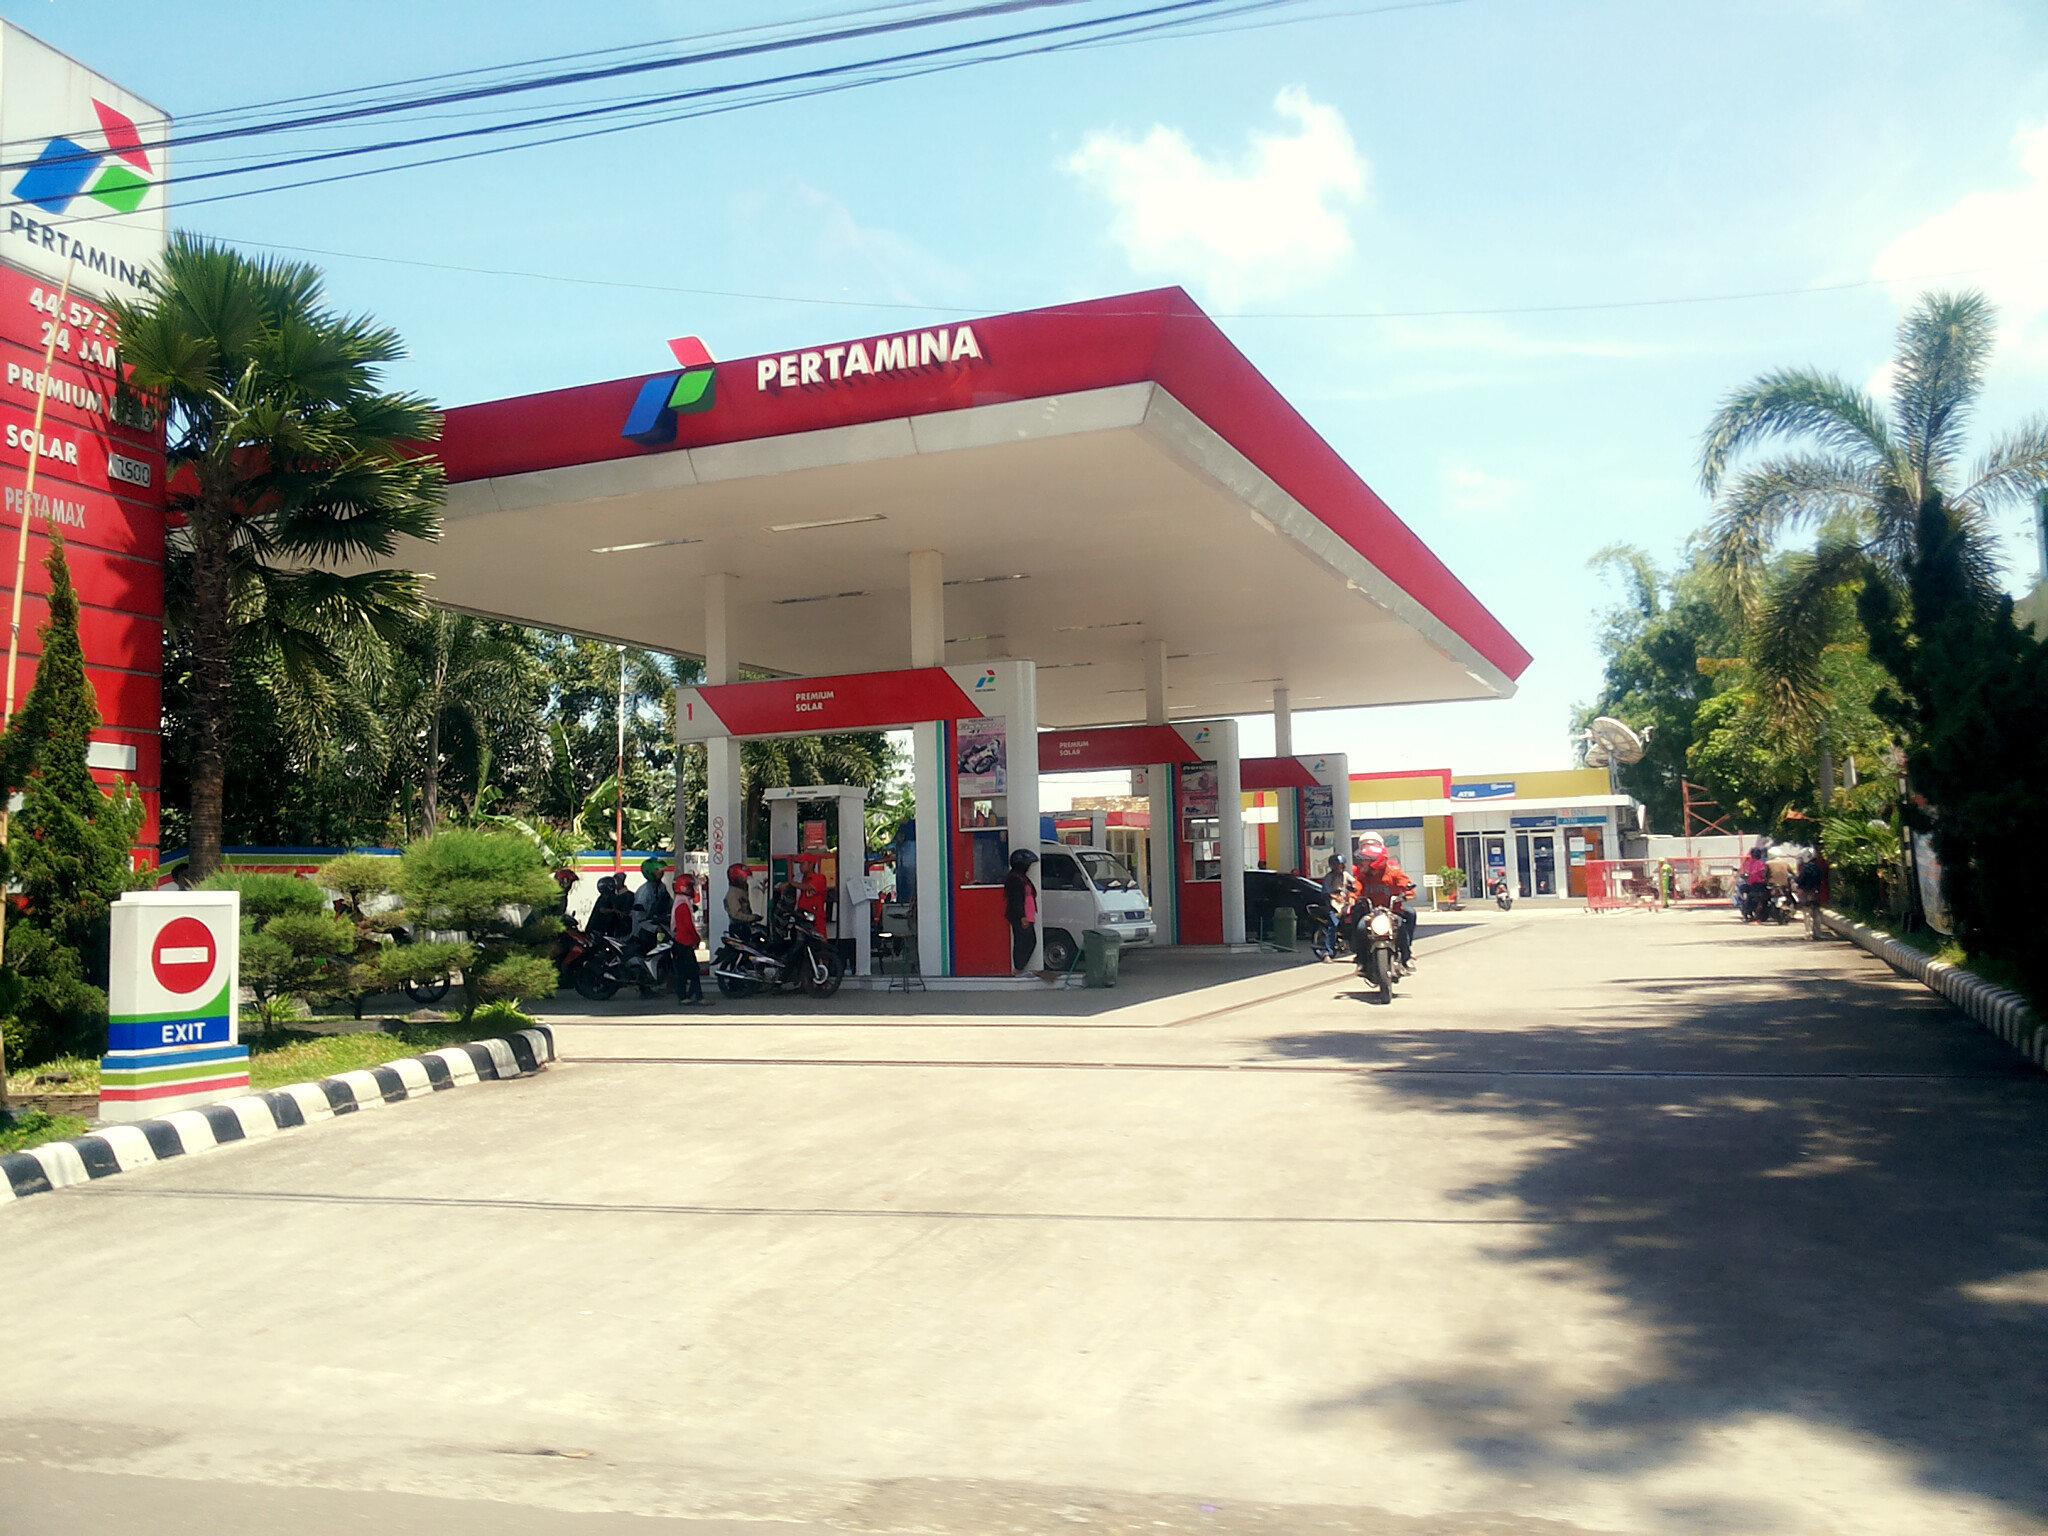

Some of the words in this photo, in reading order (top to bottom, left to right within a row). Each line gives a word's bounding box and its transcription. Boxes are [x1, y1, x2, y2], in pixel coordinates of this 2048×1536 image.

[10, 210, 154, 294] PERTAMINA
[41, 321, 71, 353] 24
[757, 325, 983, 392] PERTAMINA
[7, 362, 103, 414] PREMIUM
[6, 424, 78, 466] SOLAR
[795, 691, 835, 701] PREMIUM
[795, 702, 823, 712] SOLAR
[686, 703, 693, 721] 1
[1059, 740, 1089, 749] PREMIUM
[1136, 773, 1144, 785] 3
[161, 1022, 207, 1044] EXIT
